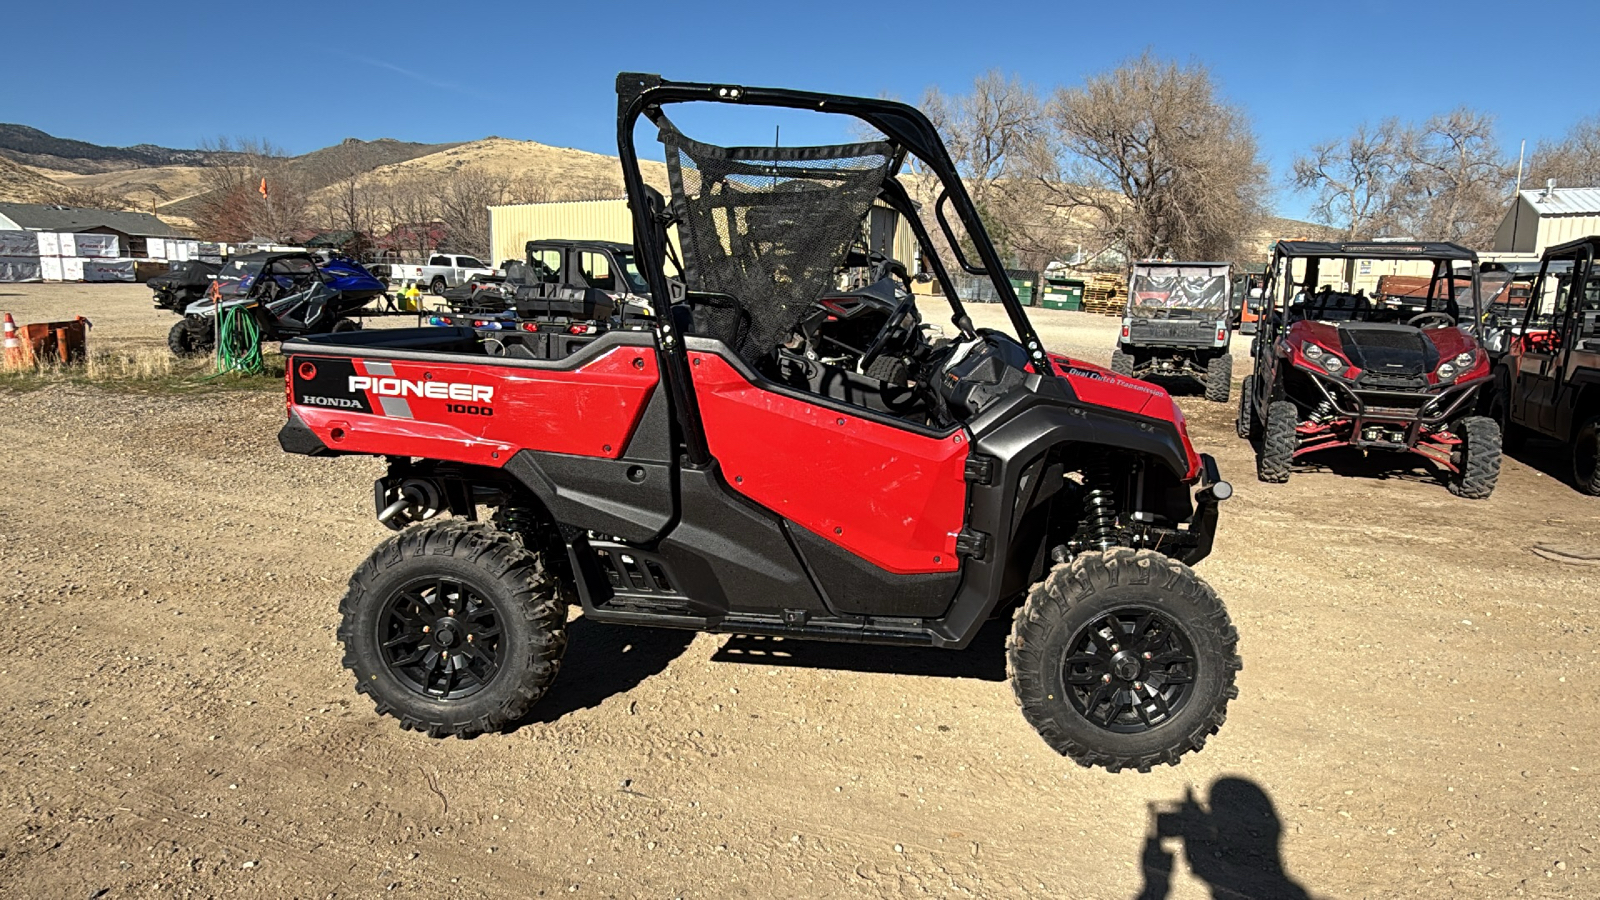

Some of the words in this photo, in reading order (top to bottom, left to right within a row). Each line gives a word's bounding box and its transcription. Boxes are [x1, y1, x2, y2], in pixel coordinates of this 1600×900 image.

[348, 375, 494, 403] PIONEER
[1069, 368, 1089, 378] Dual
[1089, 372, 1115, 383] Clutch
[1116, 380, 1165, 397] Transmission
[302, 395, 364, 409] HONDA
[445, 403, 494, 416] 1000
